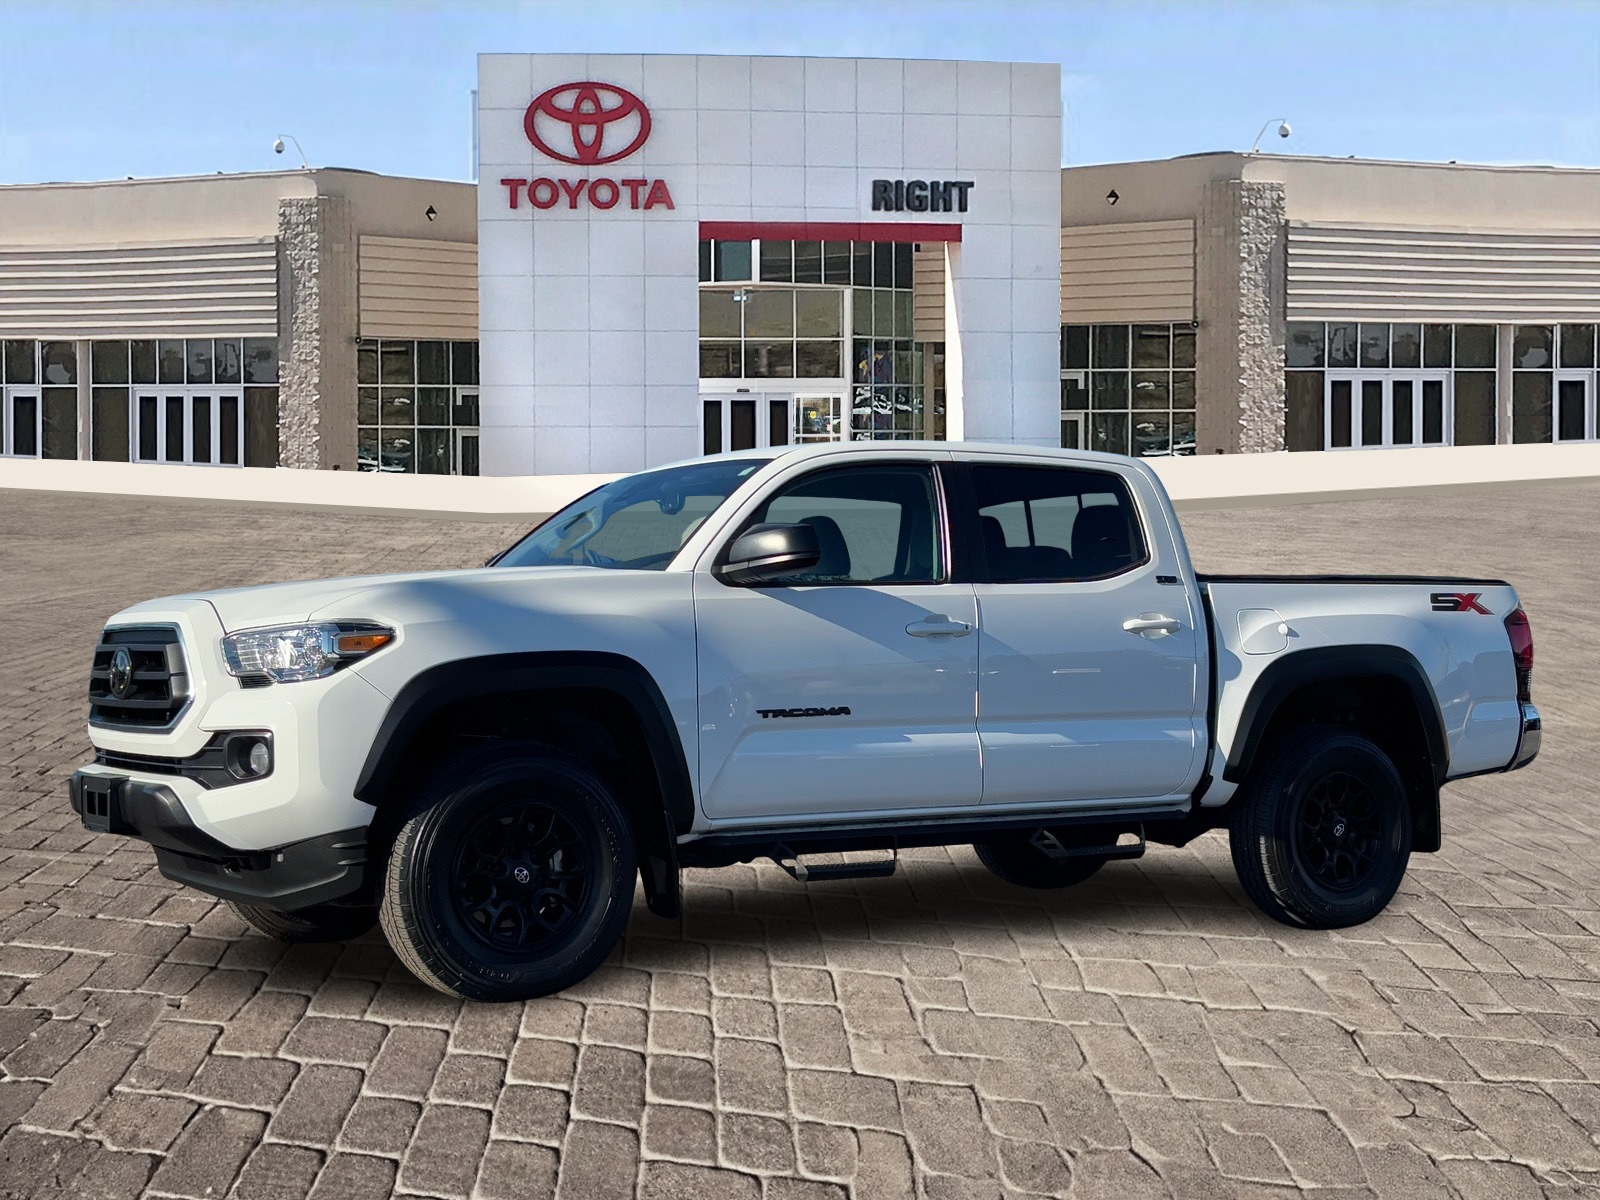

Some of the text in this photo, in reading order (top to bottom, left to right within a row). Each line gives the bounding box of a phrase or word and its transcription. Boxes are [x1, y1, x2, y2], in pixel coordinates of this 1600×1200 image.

[500, 178, 675, 210] TOYOTA
[872, 180, 975, 212] RIGHT
[756, 706, 851, 719] TACOMA
